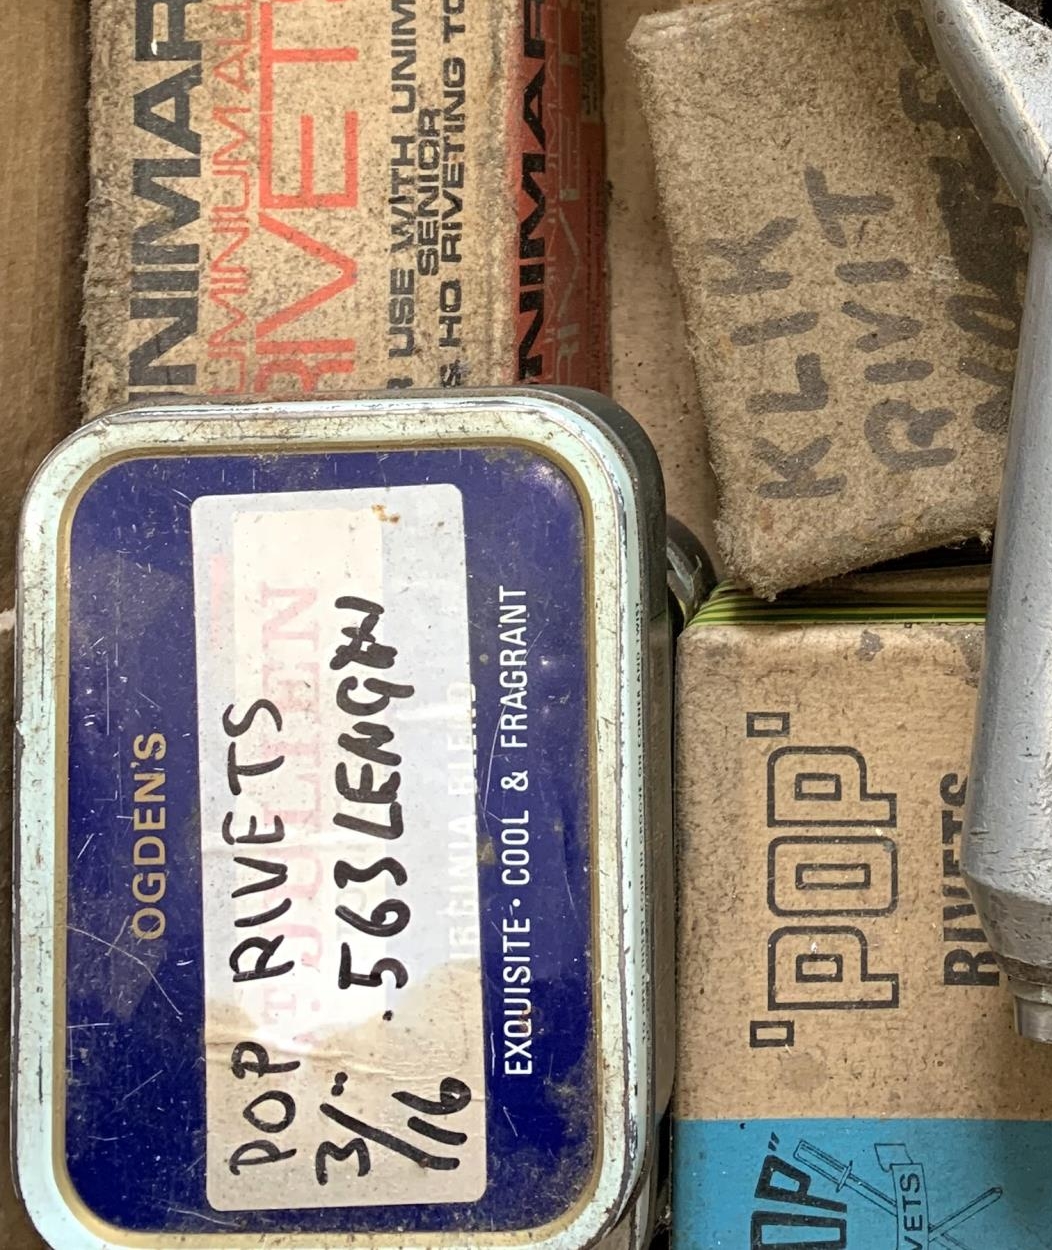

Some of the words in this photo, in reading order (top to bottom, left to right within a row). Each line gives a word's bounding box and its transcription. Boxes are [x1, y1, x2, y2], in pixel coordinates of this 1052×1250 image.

[387, 135, 418, 253] WITH
[416, 106, 442, 277] SENIOR
[438, 57, 467, 265] RIVETING
[207, 107, 252, 394] UMINIUM
[388, 267, 417, 360] USE
[705, 214, 848, 501] KLIK
[497, 584, 529, 750] FRAGRANT
[128, 732, 168, 941] OGDEN'S
[221, 698, 295, 983] RIVETS
[499, 769, 531, 793] &
[499, 809, 531, 887] COOL
[501, 918, 534, 1076] EXQUISITE
[228, 1041, 301, 1177] POP
[897, 1171, 927, 1250] VETS
